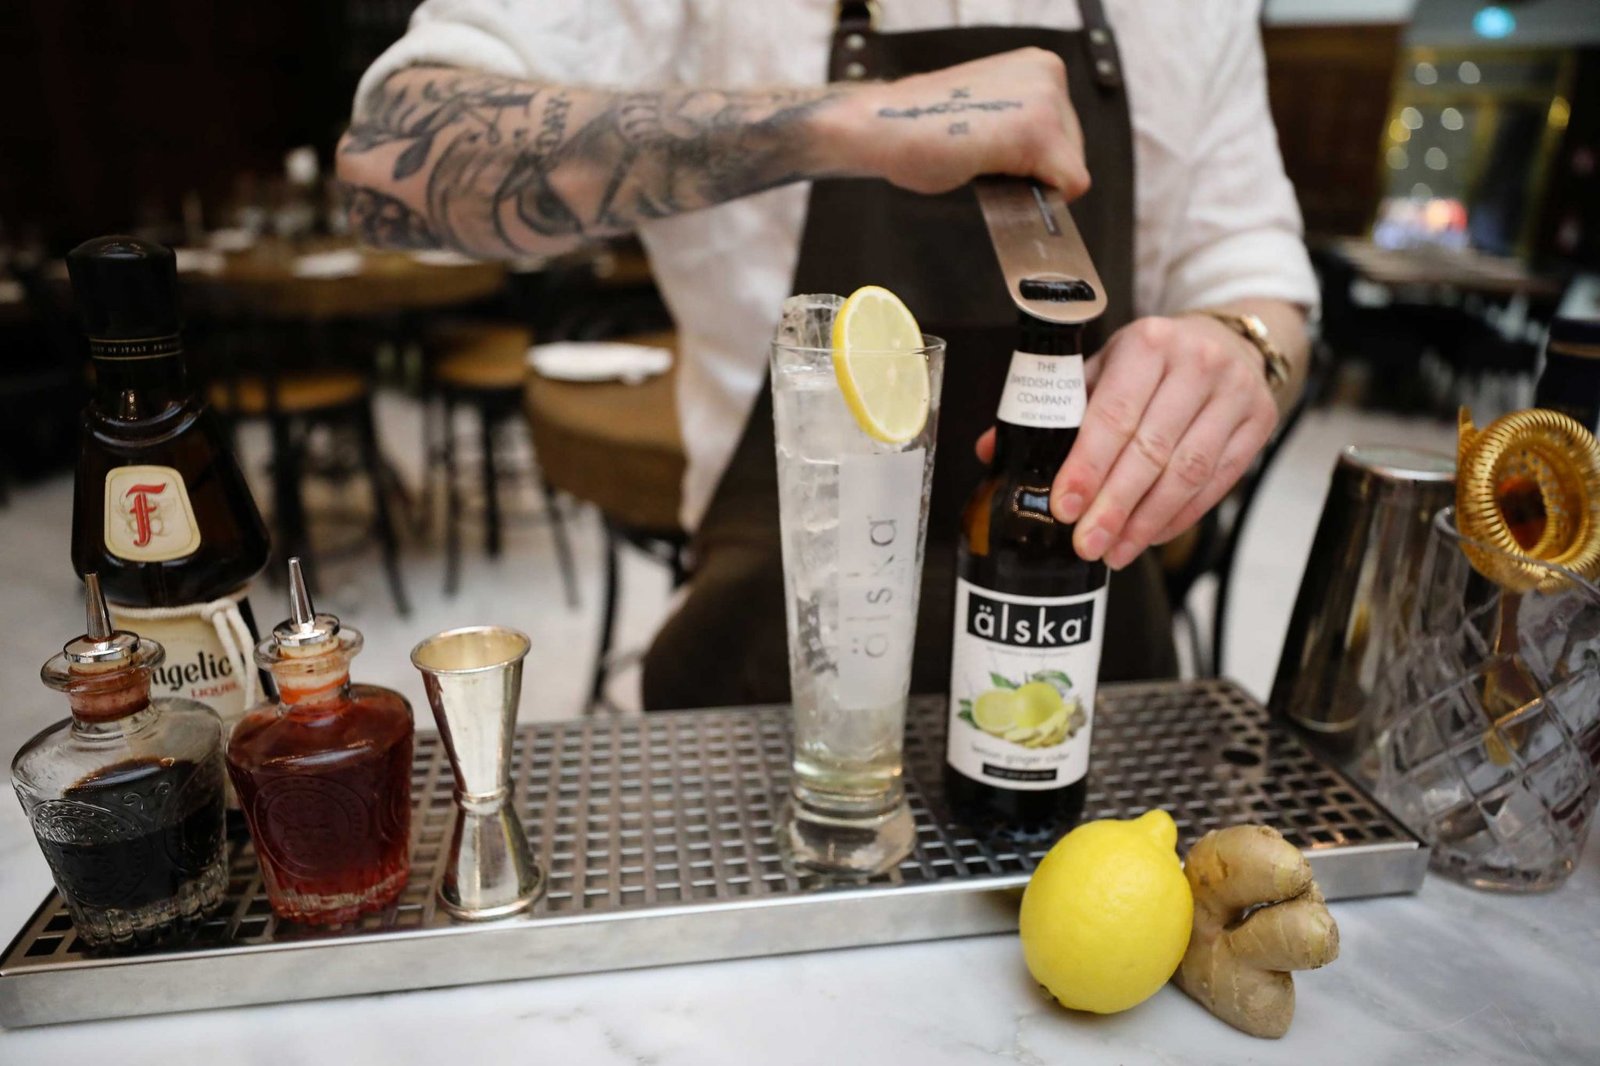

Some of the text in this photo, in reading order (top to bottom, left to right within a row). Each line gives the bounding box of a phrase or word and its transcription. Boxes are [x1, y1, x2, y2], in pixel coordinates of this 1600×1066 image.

[1037, 362, 1057, 373] THE
[1017, 393, 1072, 406] COMPANY
[973, 603, 1083, 644] älska
[152, 651, 246, 691] ngelic
[1006, 754, 1041, 767] ginger
